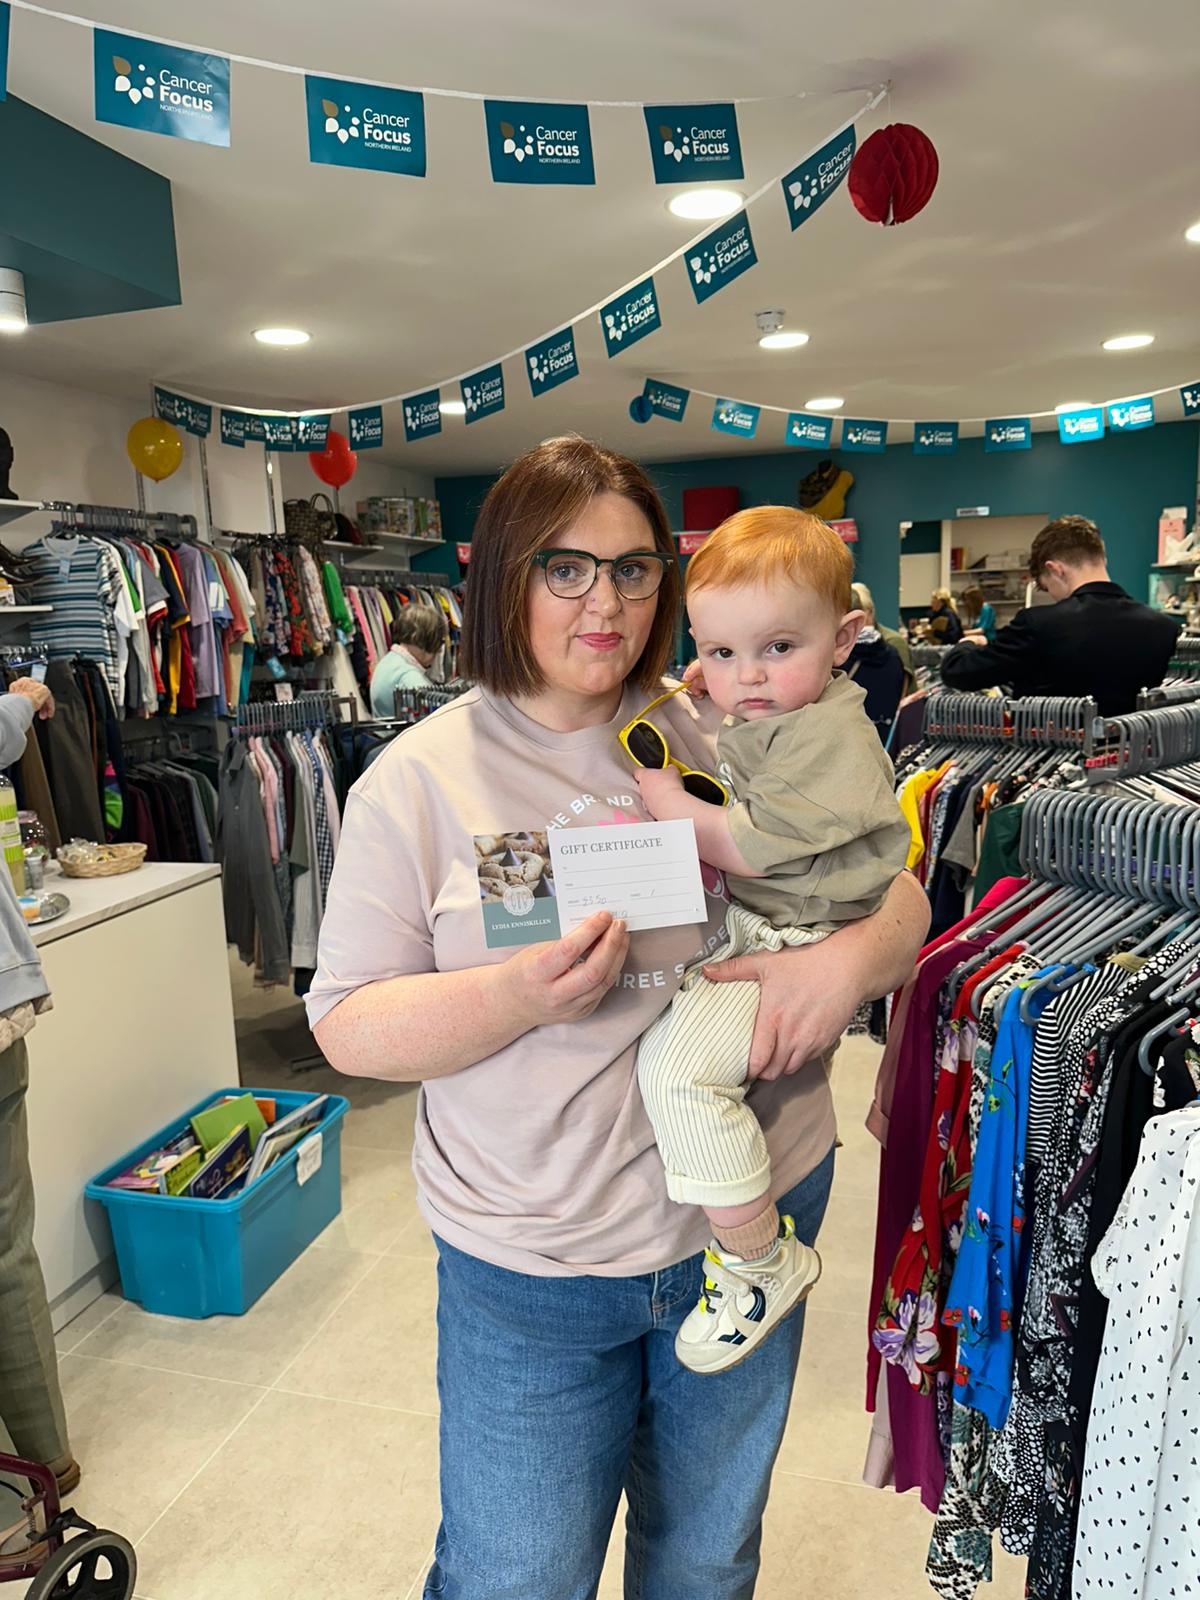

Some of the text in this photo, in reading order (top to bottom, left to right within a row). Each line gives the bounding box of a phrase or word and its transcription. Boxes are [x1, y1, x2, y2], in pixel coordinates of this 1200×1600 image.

[159, 69, 213, 95] Cancer
[159, 84, 213, 112] Focus
[363, 108, 410, 128] Cancer
[363, 123, 412, 144] Focus
[536, 126, 577, 141] Cancer
[691, 127, 726, 140] Cancer
[364, 141, 391, 150] NORTHERN
[537, 141, 580, 157] Focus
[692, 140, 729, 155] Focus
[817, 142, 853, 176] Cancer
[820, 154, 853, 189] Focus
[715, 226, 746, 254] Cancer
[717, 239, 750, 268] Focus
[626, 292, 652, 315] Cancer
[627, 304, 655, 327] Focus
[548, 341, 572, 359] Cancer
[549, 352, 574, 371] Focus
[480, 377, 501, 392] Cancer
[482, 388, 502, 403] Focus
[420, 402, 440, 413] Cancer
[661, 399, 681, 410] Focus
[420, 411, 439, 424] Focus
[310, 432, 327, 440] Focus
[364, 427, 381, 437] Focus
[545, 793, 633, 831] HE BRND
[560, 838, 663, 855] GIFT CERTIFICATE
[492, 919, 551, 931] LYDIA ENNISKILLEN
